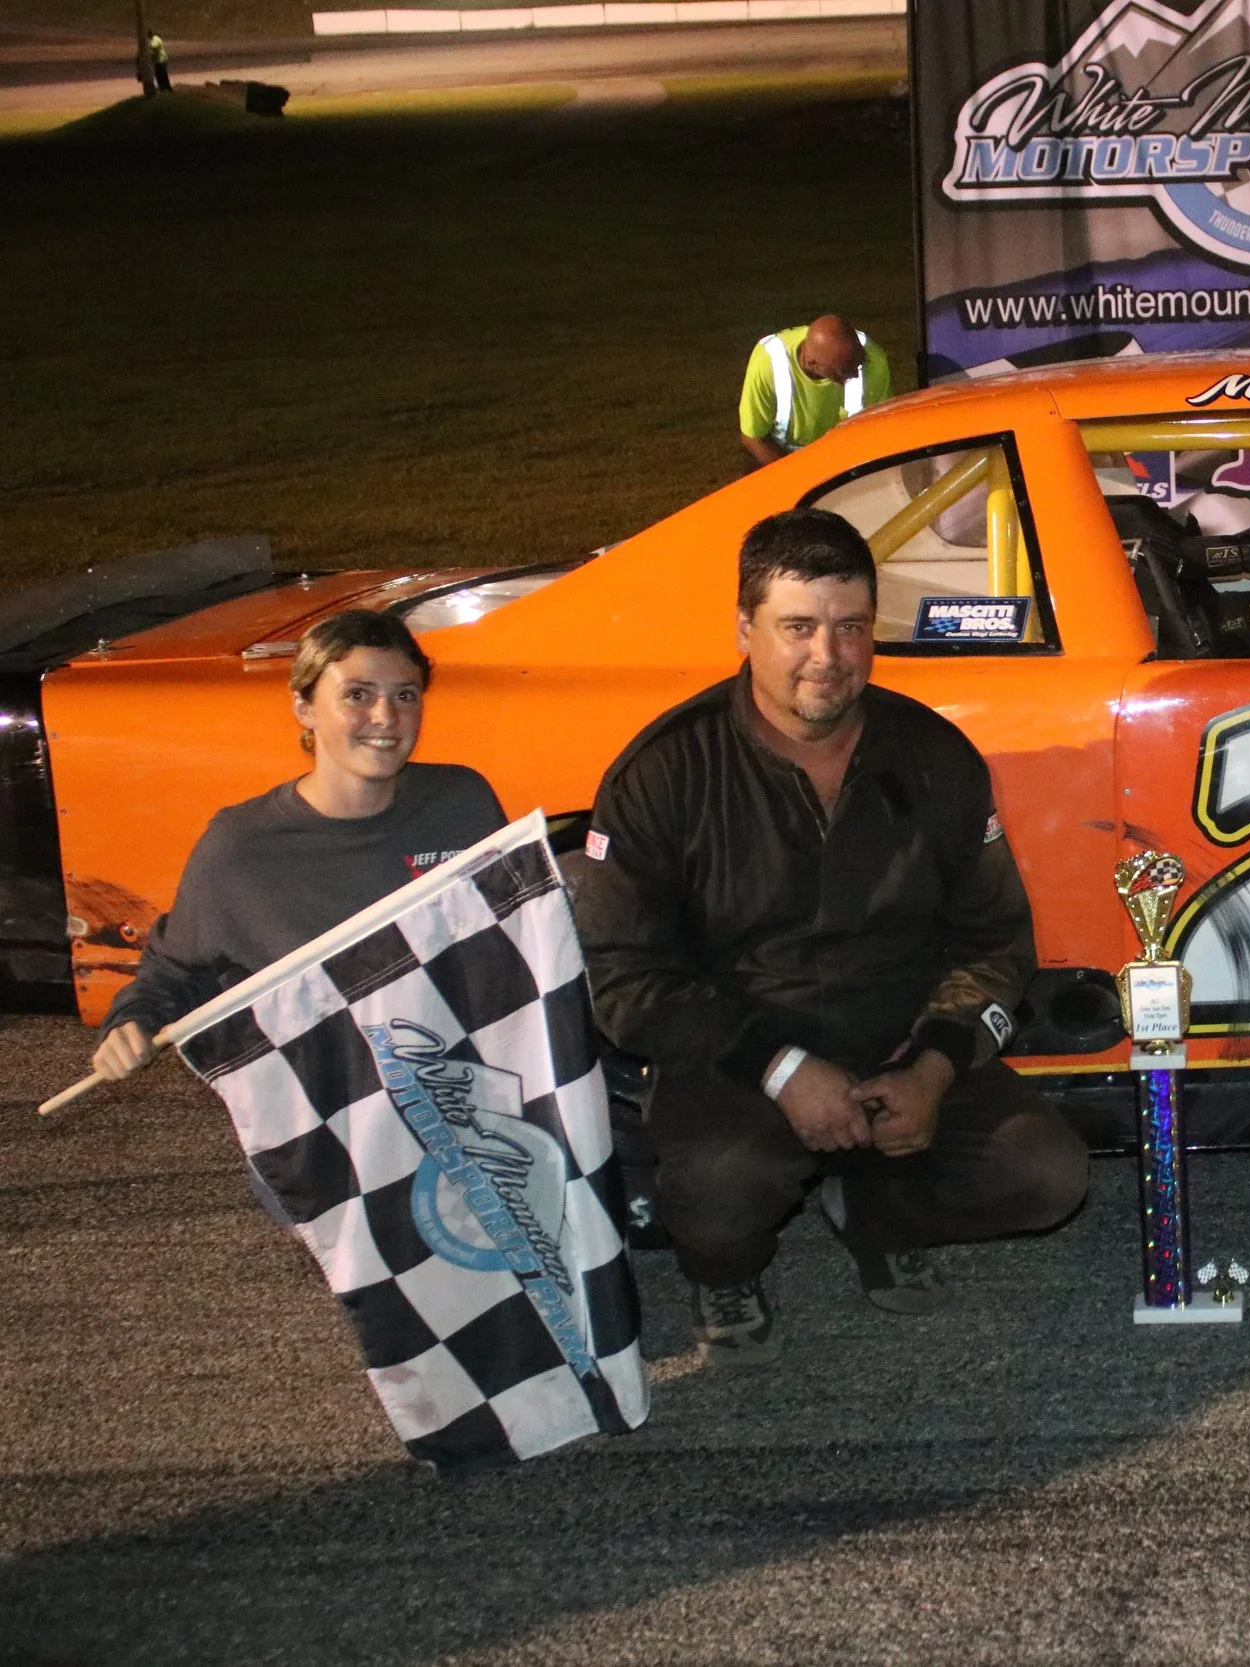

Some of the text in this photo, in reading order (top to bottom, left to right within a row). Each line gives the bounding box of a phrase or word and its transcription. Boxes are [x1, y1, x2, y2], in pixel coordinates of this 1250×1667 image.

[972, 65, 1157, 144] White
[959, 617, 1018, 631] BROS.
[412, 851, 437, 867] JEFF
[1136, 1022, 1178, 1033] 1st Place
